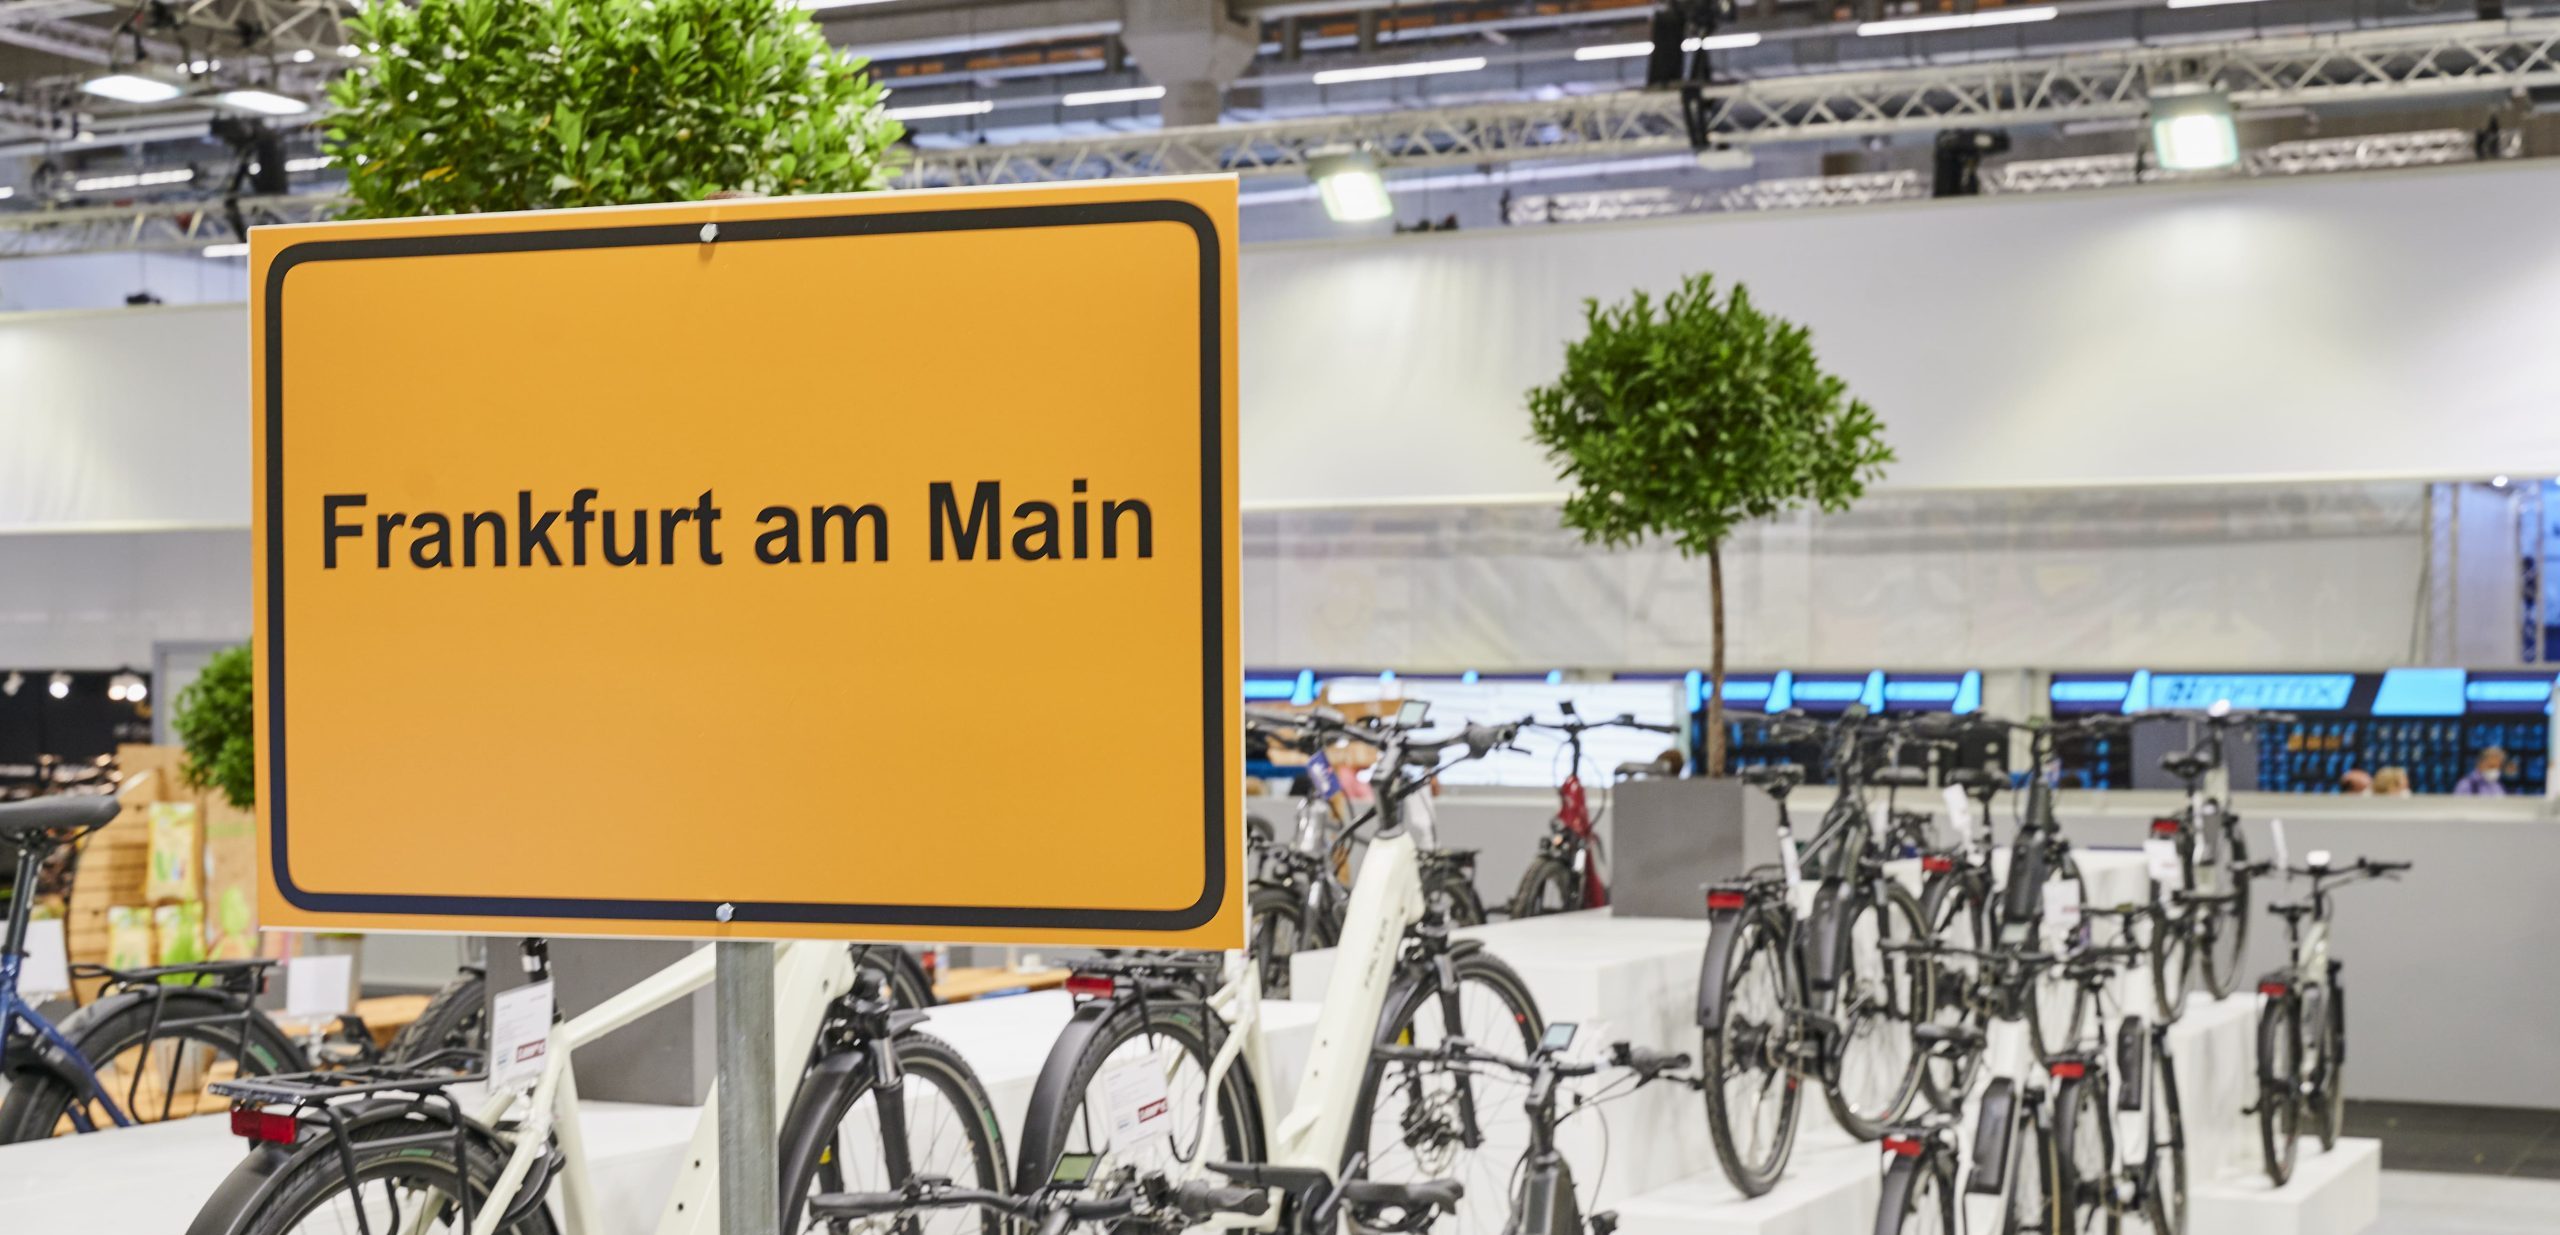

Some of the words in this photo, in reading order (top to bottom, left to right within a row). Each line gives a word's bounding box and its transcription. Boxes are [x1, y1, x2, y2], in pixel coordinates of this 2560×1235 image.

[322, 488, 723, 570] Frankfurt
[754, 504, 889, 566] am
[929, 479, 1154, 562] Main
